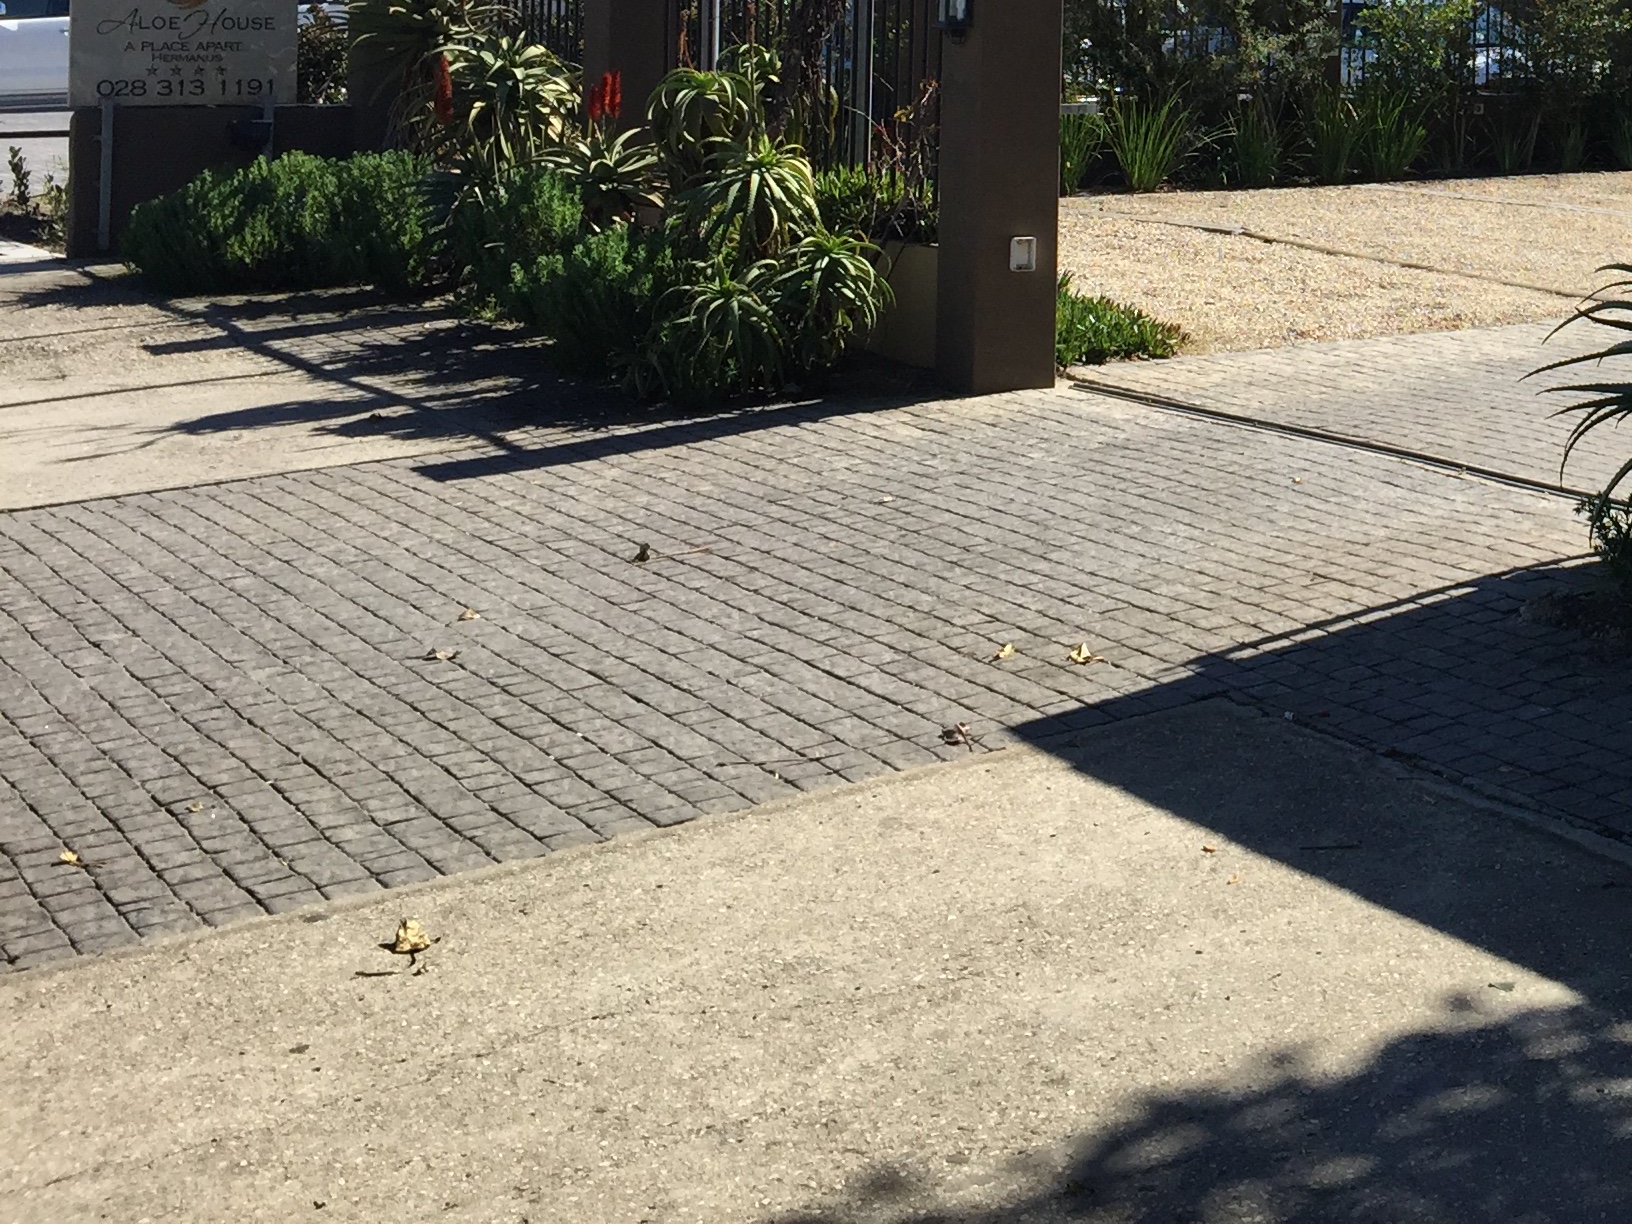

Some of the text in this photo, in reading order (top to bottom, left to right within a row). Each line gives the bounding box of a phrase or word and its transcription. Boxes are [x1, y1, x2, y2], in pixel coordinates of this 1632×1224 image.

[97, 8, 276, 40] ALOE HOUSE
[124, 41, 242, 52] A PLACE APART
[151, 53, 223, 63] HERMANUS
[96, 78, 274, 96] 028 313 1191
